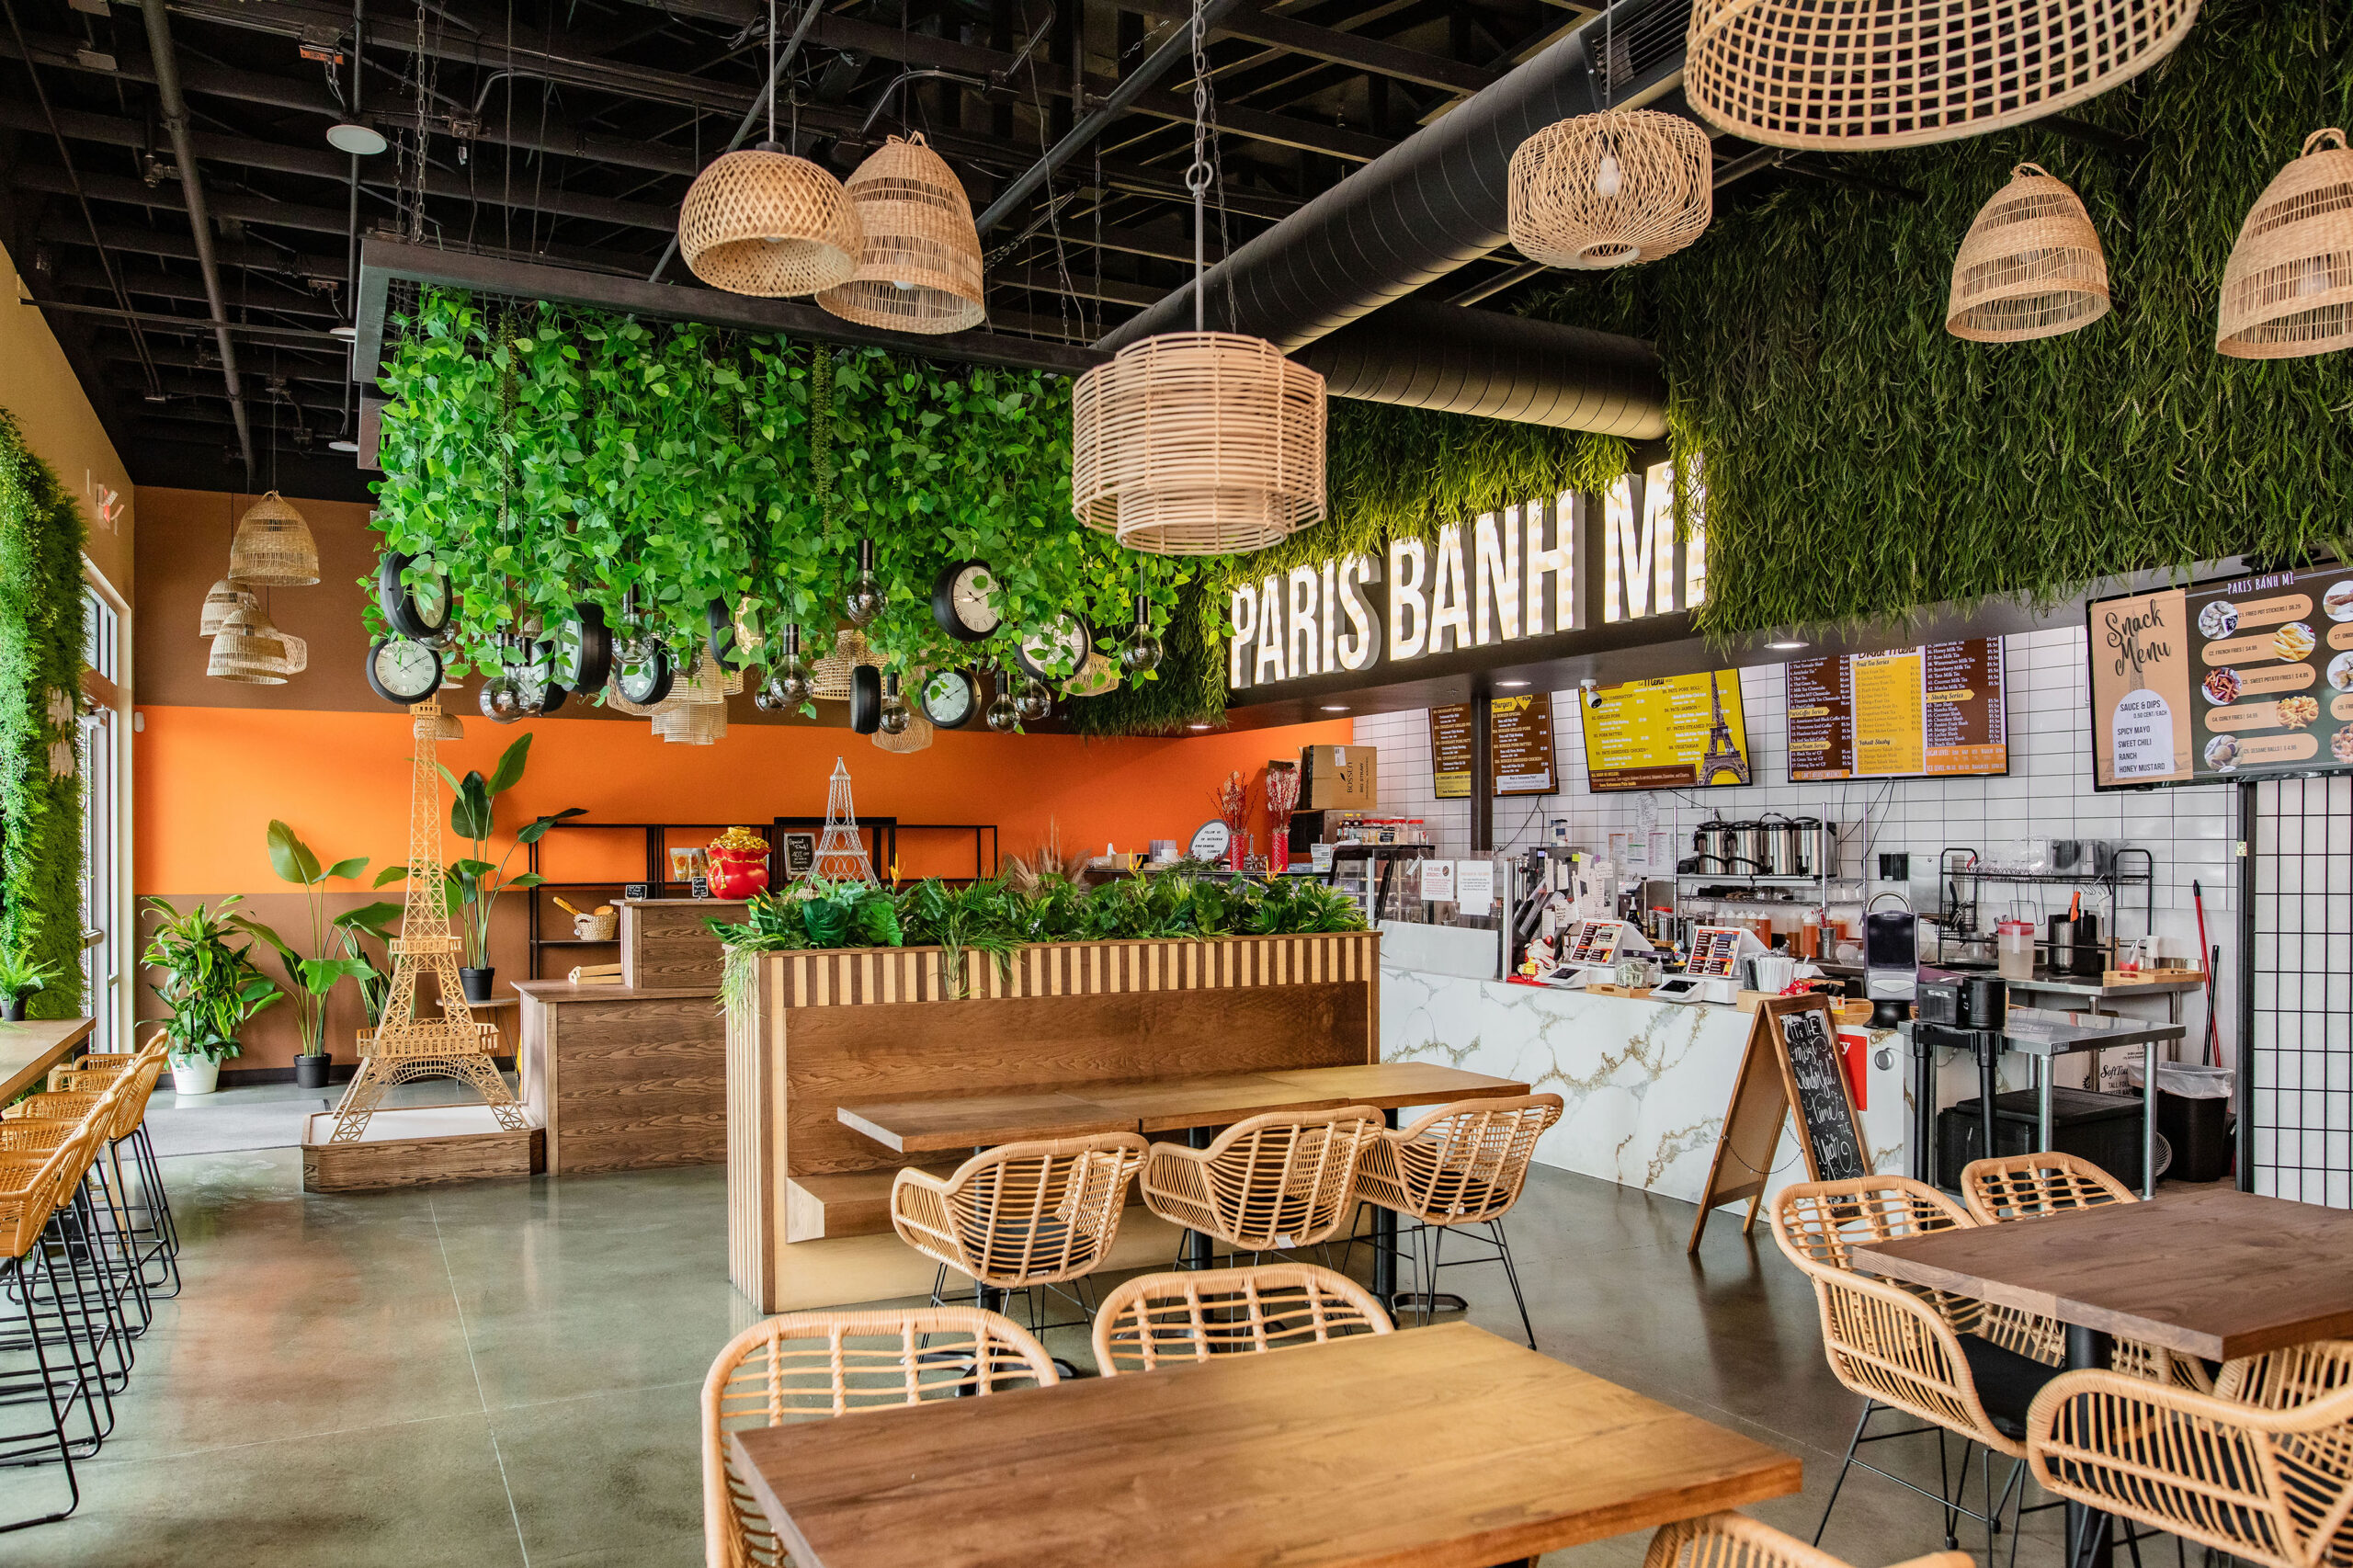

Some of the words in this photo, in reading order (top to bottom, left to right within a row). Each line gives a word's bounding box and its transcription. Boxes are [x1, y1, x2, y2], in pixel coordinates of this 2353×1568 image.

[1231, 551, 1381, 689] PARIS
[1390, 489, 1585, 661] BANH
[2228, 580, 2252, 595] PARIS
[2256, 575, 2279, 590] BÁNH
[2106, 599, 2165, 647] Snack
[2115, 637, 2170, 676] Menu
[2120, 702, 2139, 711] SAUCE
[2147, 700, 2160, 709] DIPS
[2118, 727, 2132, 735] SPICY
[2138, 738, 2152, 746] CHILI
[2119, 752, 2137, 760] RANCH
[2120, 765, 2137, 773] HONEY
[2139, 763, 2165, 772] MUSTARD
[1802, 1017, 1819, 1037] THE
